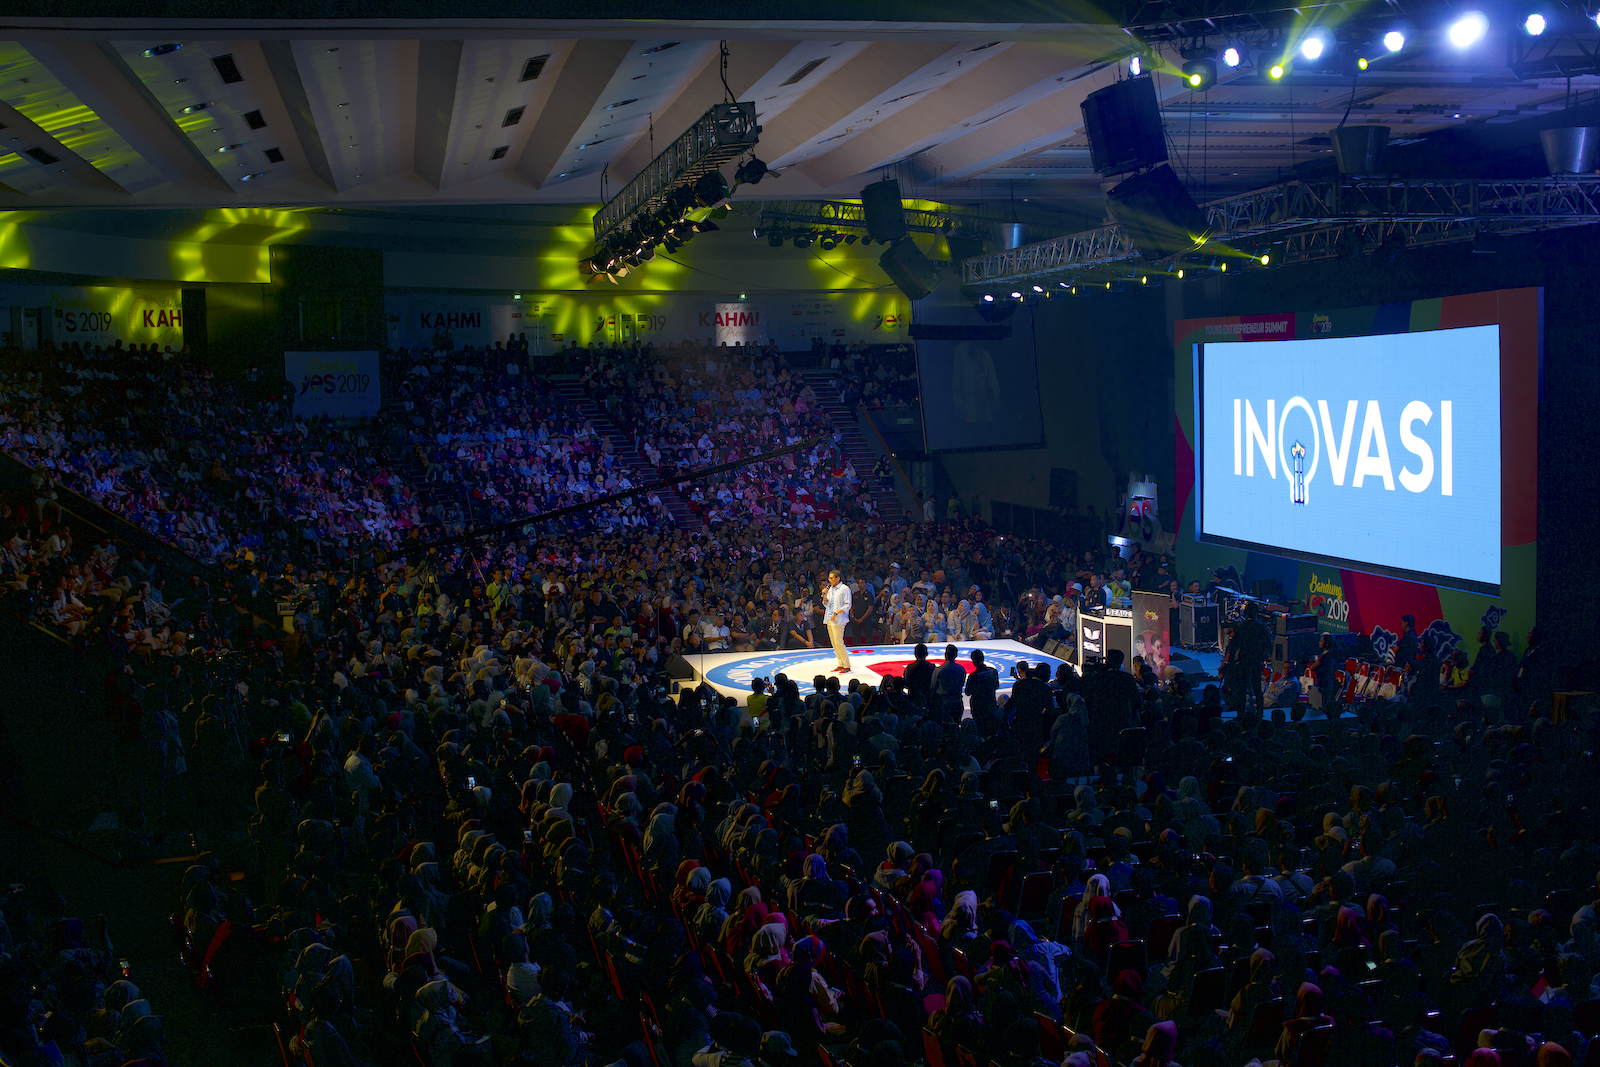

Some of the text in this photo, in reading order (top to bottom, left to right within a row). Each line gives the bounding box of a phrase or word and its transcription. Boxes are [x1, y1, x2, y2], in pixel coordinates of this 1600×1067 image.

[79, 312, 112, 331] 2019
[143, 309, 182, 328] KAH
[420, 312, 481, 328] KAHMI
[698, 312, 759, 327] KAHMI
[1204, 320, 1288, 336] YOUNG ENTREPRENEUR SUMMIT
[307, 354, 357, 375] Bandung
[338, 374, 370, 393] 2019
[1233, 394, 1453, 506] INOVASI
[1309, 572, 1343, 601] Bandung
[1326, 597, 1350, 622] 2019
